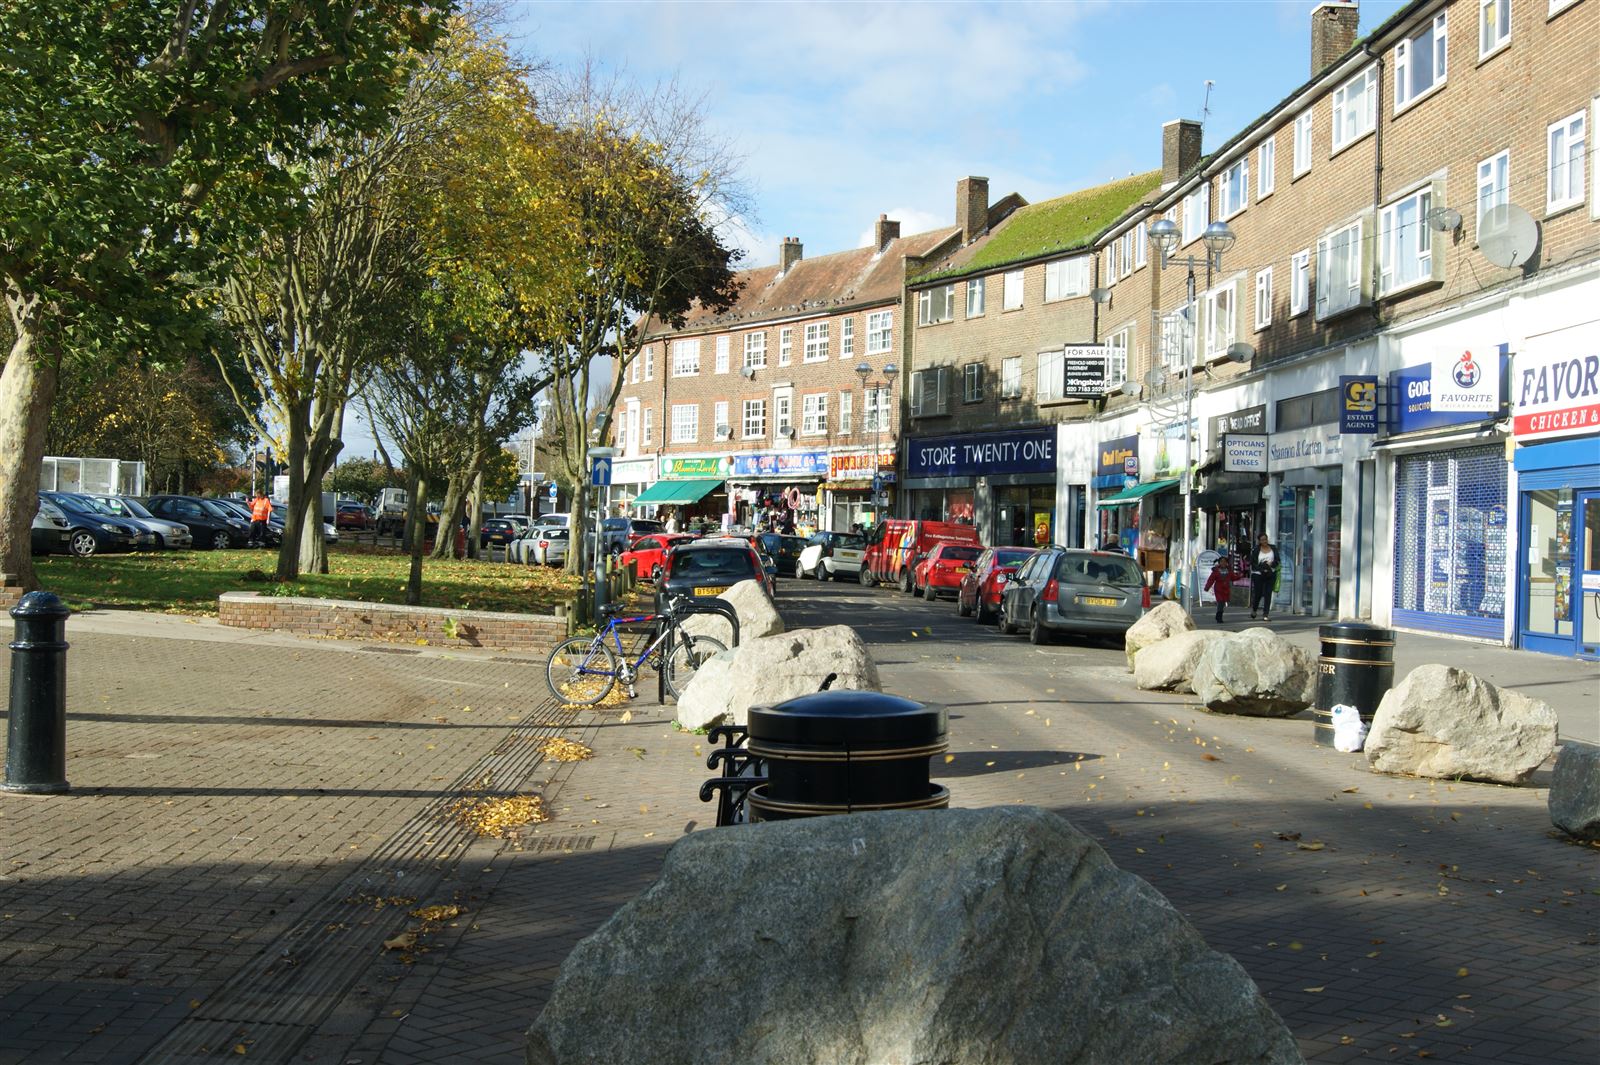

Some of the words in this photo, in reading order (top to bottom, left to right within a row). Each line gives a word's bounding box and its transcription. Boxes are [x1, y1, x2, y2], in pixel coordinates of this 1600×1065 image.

[1408, 379, 1431, 399] GOR
[1440, 394, 1493, 402] FAVORITE
[1530, 409, 1587, 431] CHICKEN
[1591, 409, 1599, 422] &
[920, 446, 956, 466] STORE
[964, 441, 1020, 464] TWENTY
[1023, 439, 1052, 461] ONE
[1226, 440, 1265, 448] OPTICIANS
